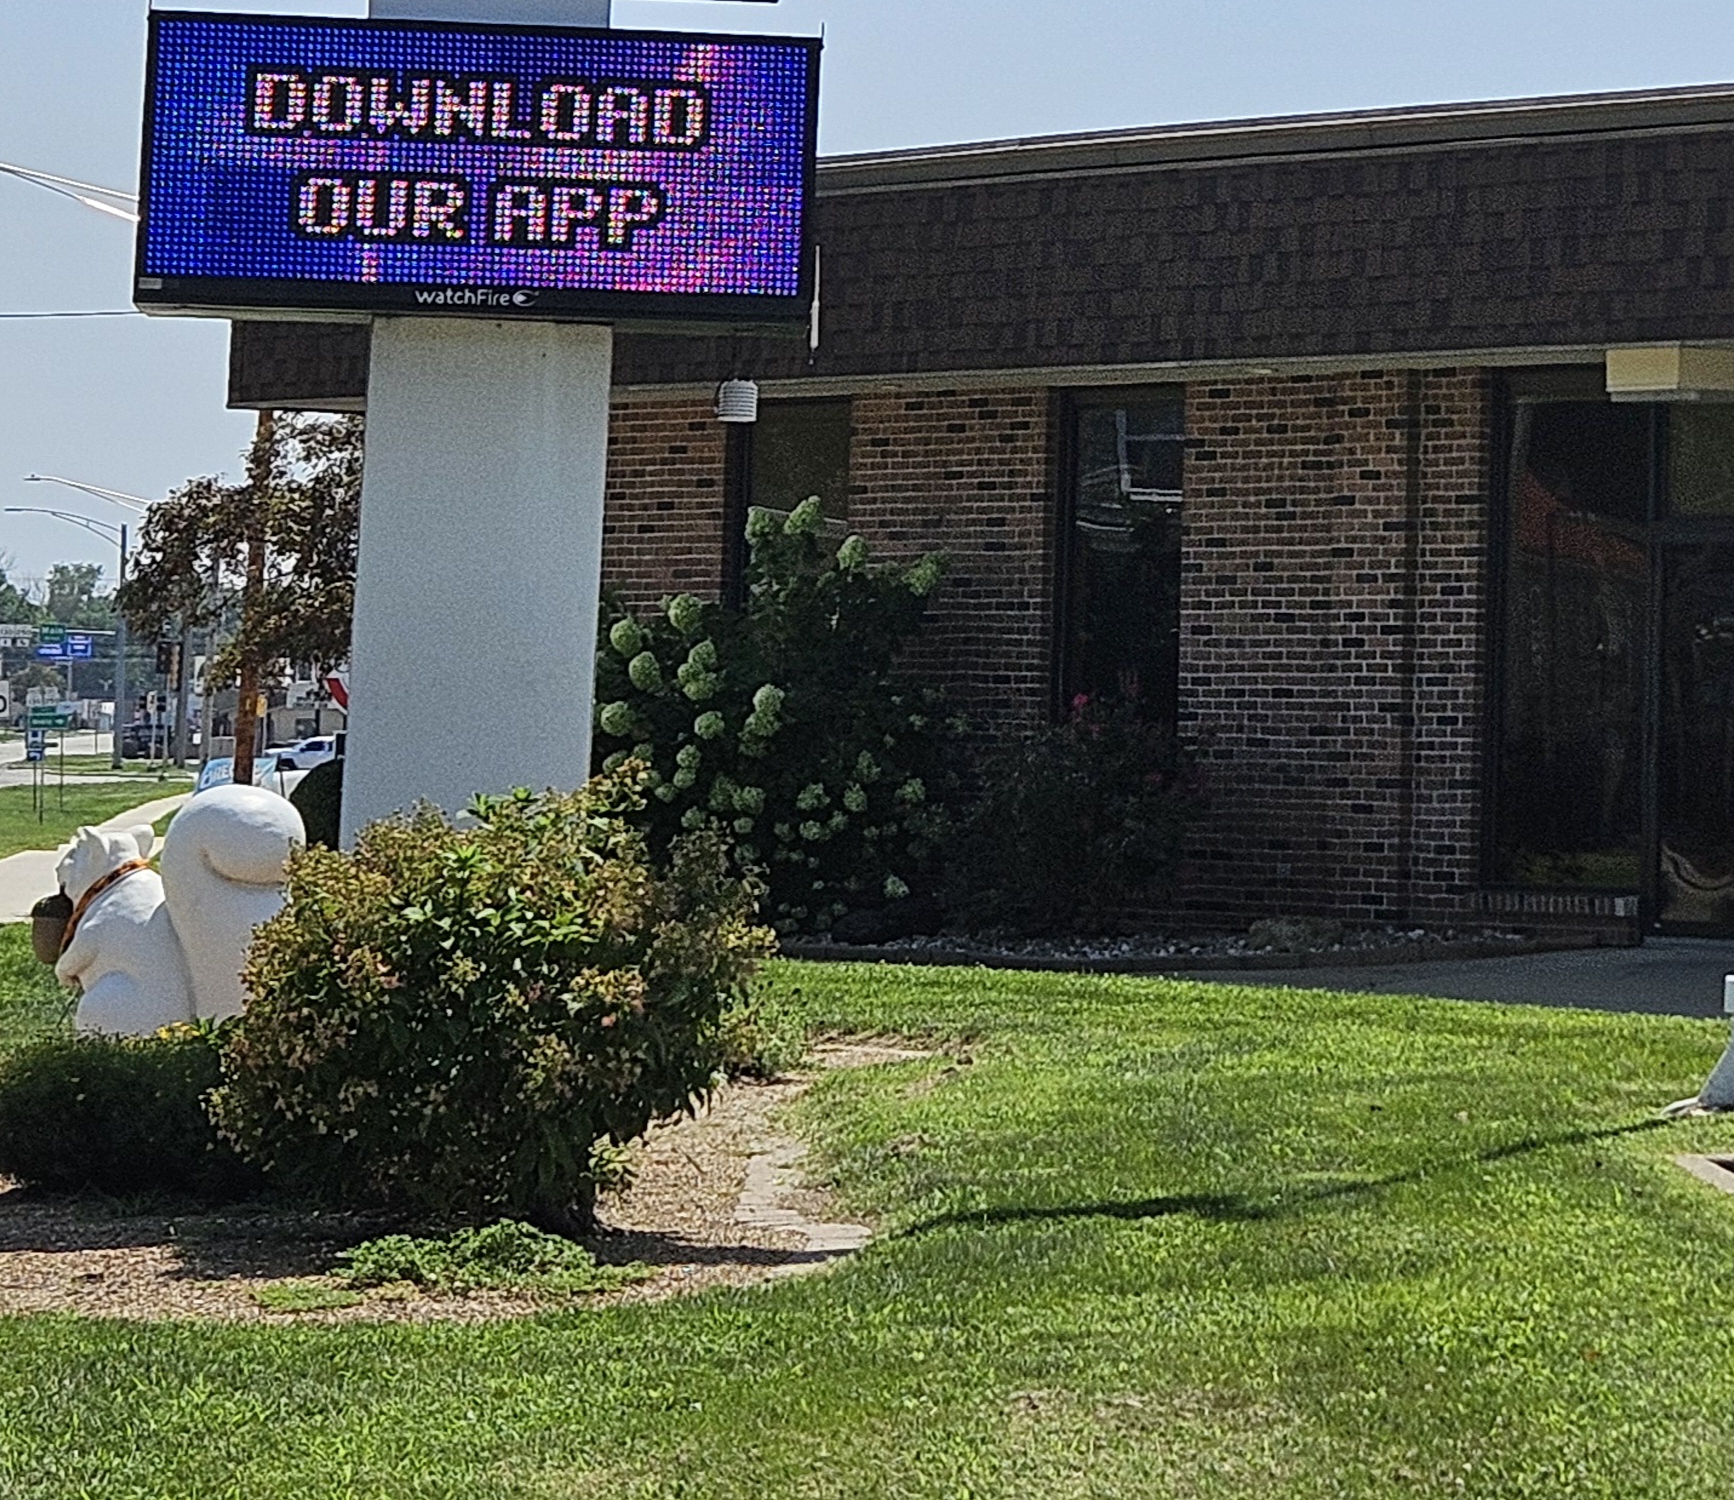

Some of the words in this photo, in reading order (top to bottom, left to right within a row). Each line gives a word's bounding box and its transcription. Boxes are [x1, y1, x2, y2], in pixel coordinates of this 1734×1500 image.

[254, 73, 704, 144] DOWNLOAD
[298, 177, 465, 239] OUR
[495, 184, 660, 244] APP
[414, 287, 511, 306] watchFire
